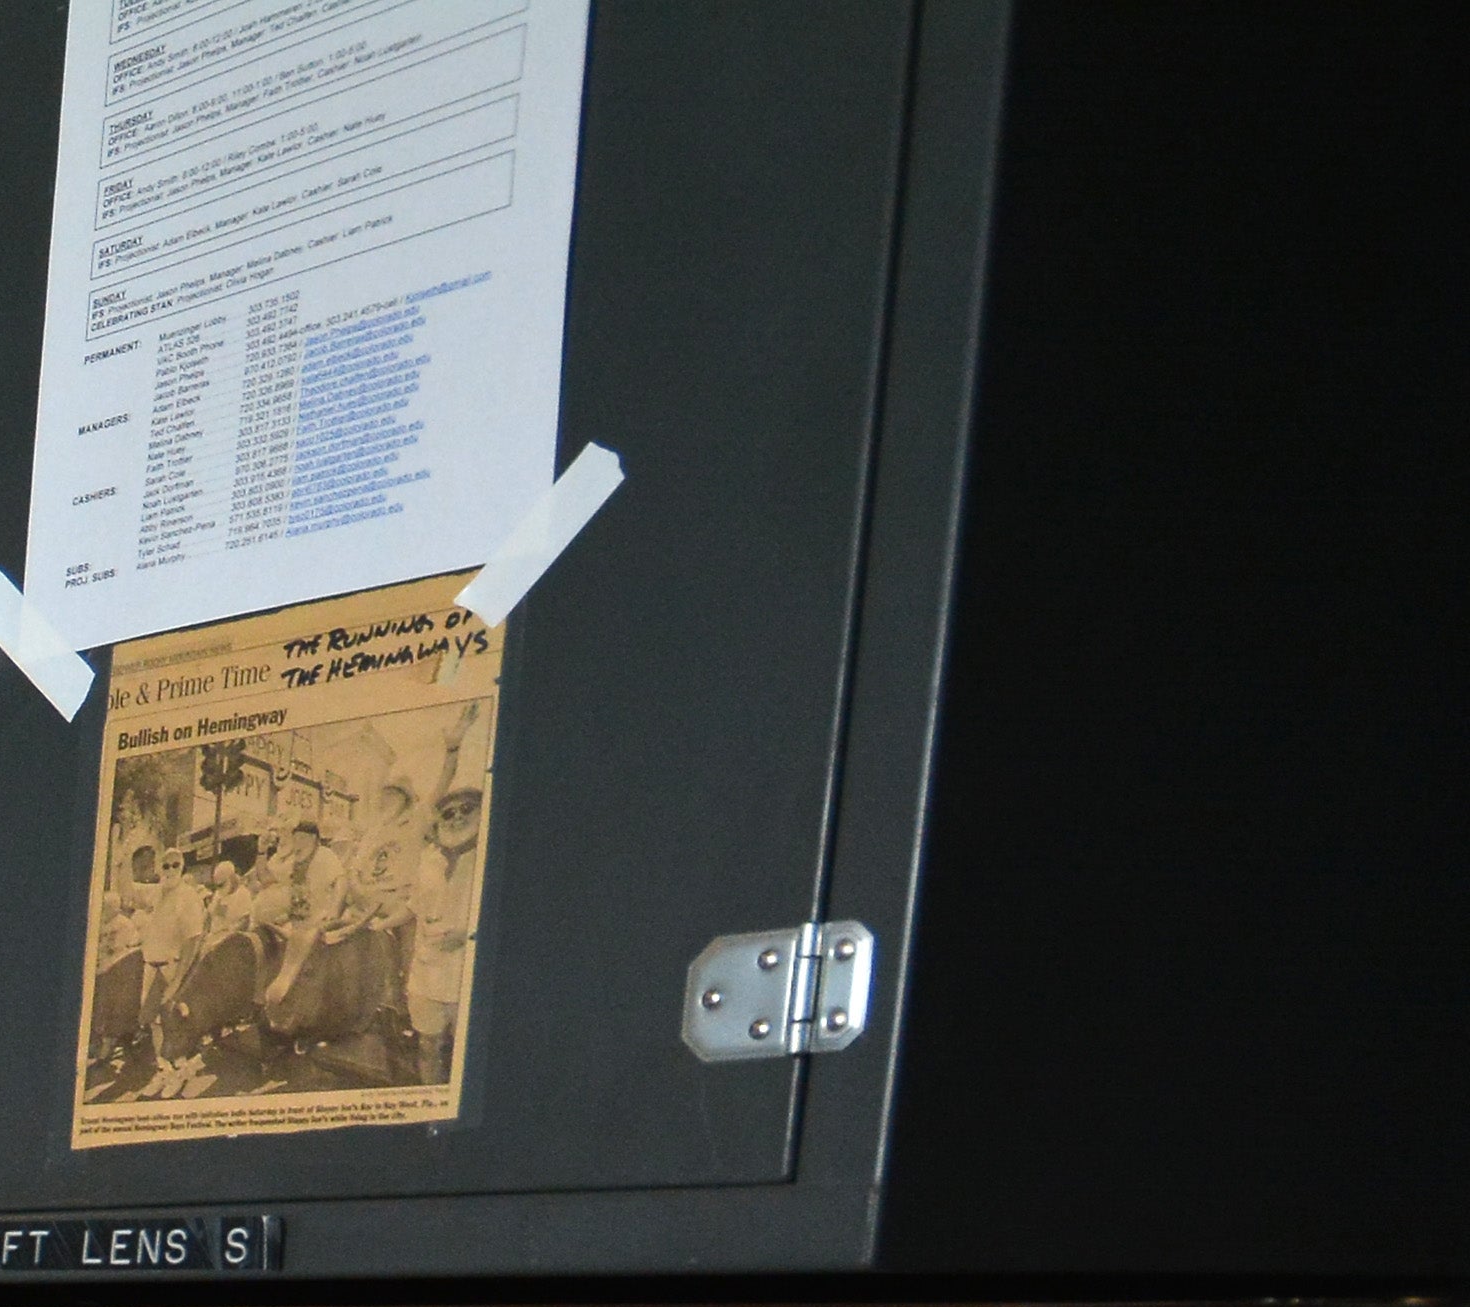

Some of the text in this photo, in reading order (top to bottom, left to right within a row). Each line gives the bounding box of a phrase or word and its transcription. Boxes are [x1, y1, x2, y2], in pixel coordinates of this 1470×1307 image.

[113, 45, 166, 73] WEDNESDAY
[108, 110, 153, 135] THURSDAY
[103, 178, 133, 197] FRIDAY
[98, 235, 143, 259] SATURDAY
[93, 290, 127, 310] SUNDAY
[90, 305, 149, 331] CELEBRATING
[84, 340, 142, 365] PERMANENT:
[78, 413, 132, 436] MANAGERS:
[72, 486, 118, 506] CASHIERS:
[66, 562, 91, 577] SUBS:
[281, 628, 489, 689] THE HEMINGWAYS
[282, 635, 318, 660] THE
[136, 681, 150, 707] &
[157, 673, 215, 702] Prime
[221, 662, 271, 689] Time
[118, 708, 288, 751] Bullish on Hemingway
[81, 1228, 187, 1266] LENS
[224, 1227, 249, 1264] S
